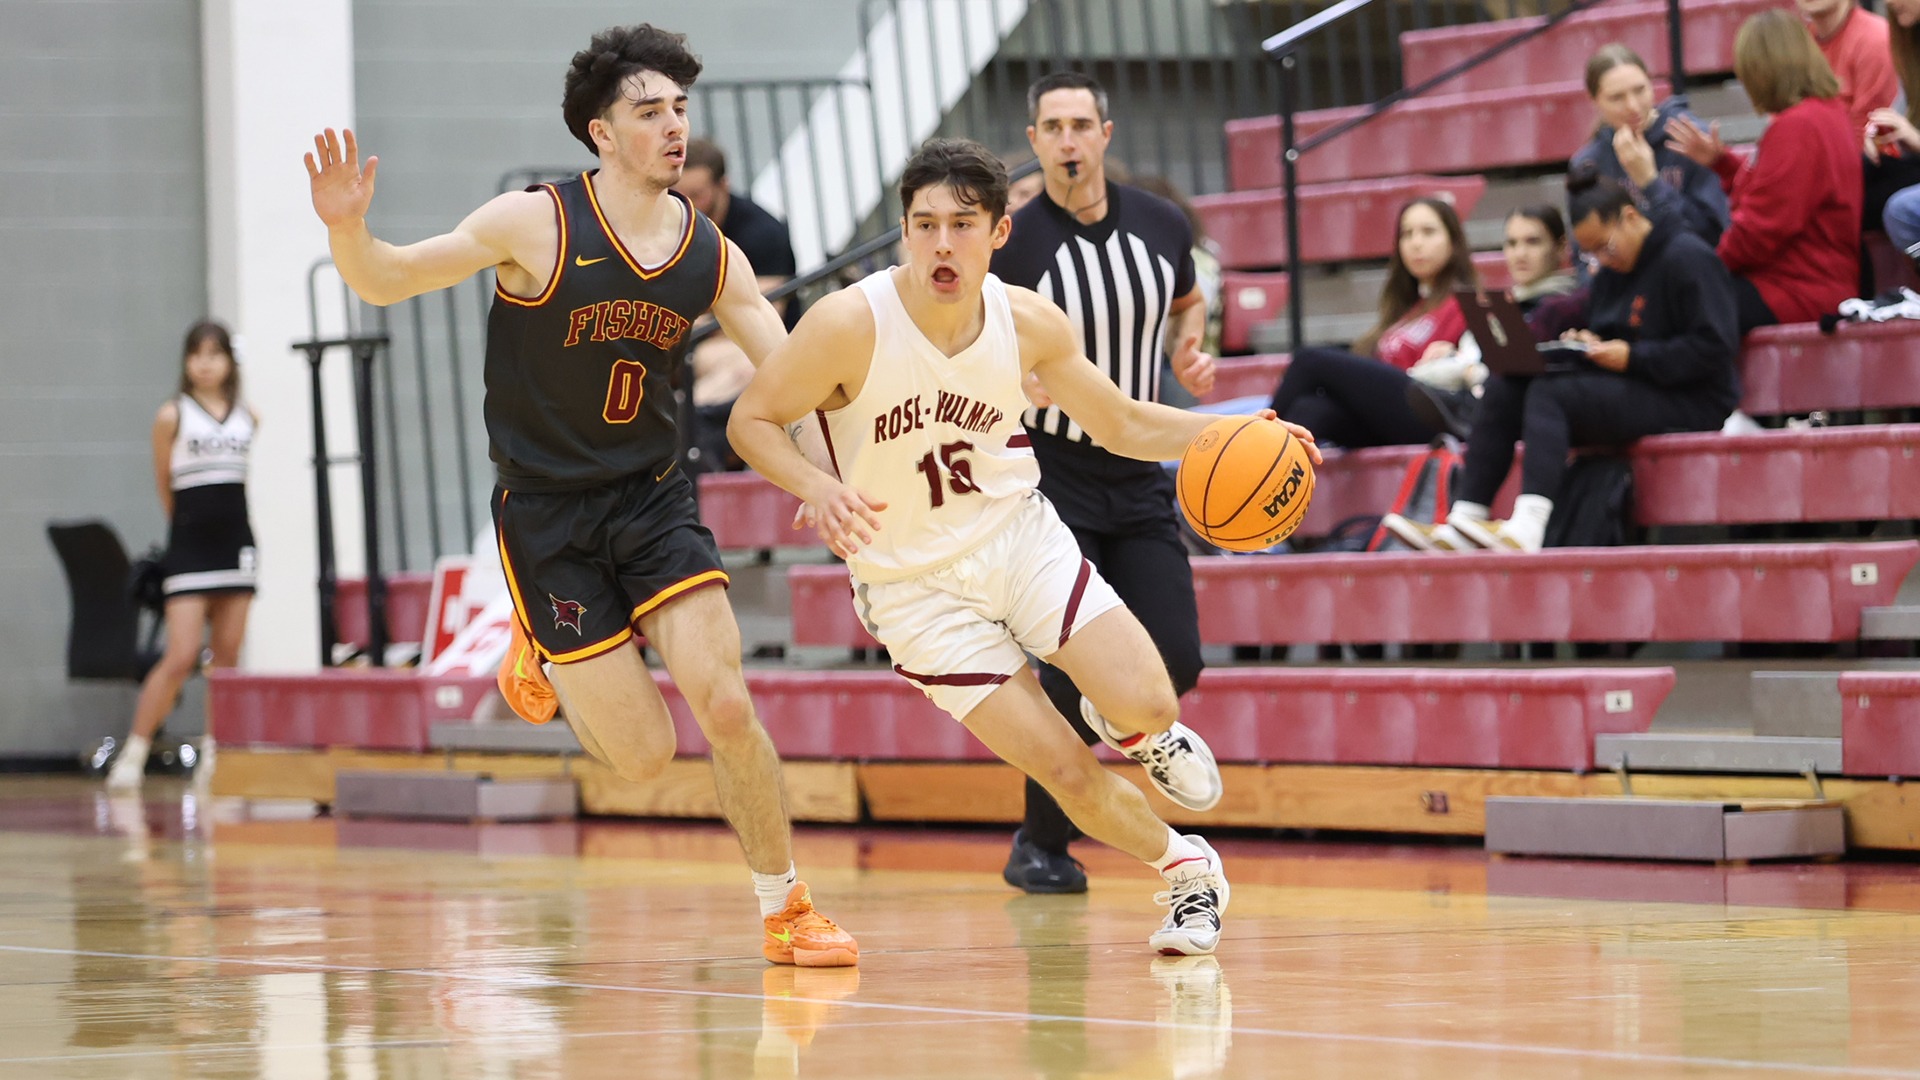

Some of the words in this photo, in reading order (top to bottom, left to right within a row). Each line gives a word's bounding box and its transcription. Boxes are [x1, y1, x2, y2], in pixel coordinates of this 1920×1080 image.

[602, 358, 646, 424] 0
[916, 440, 982, 510] 15
[1262, 460, 1305, 518] NCAA
